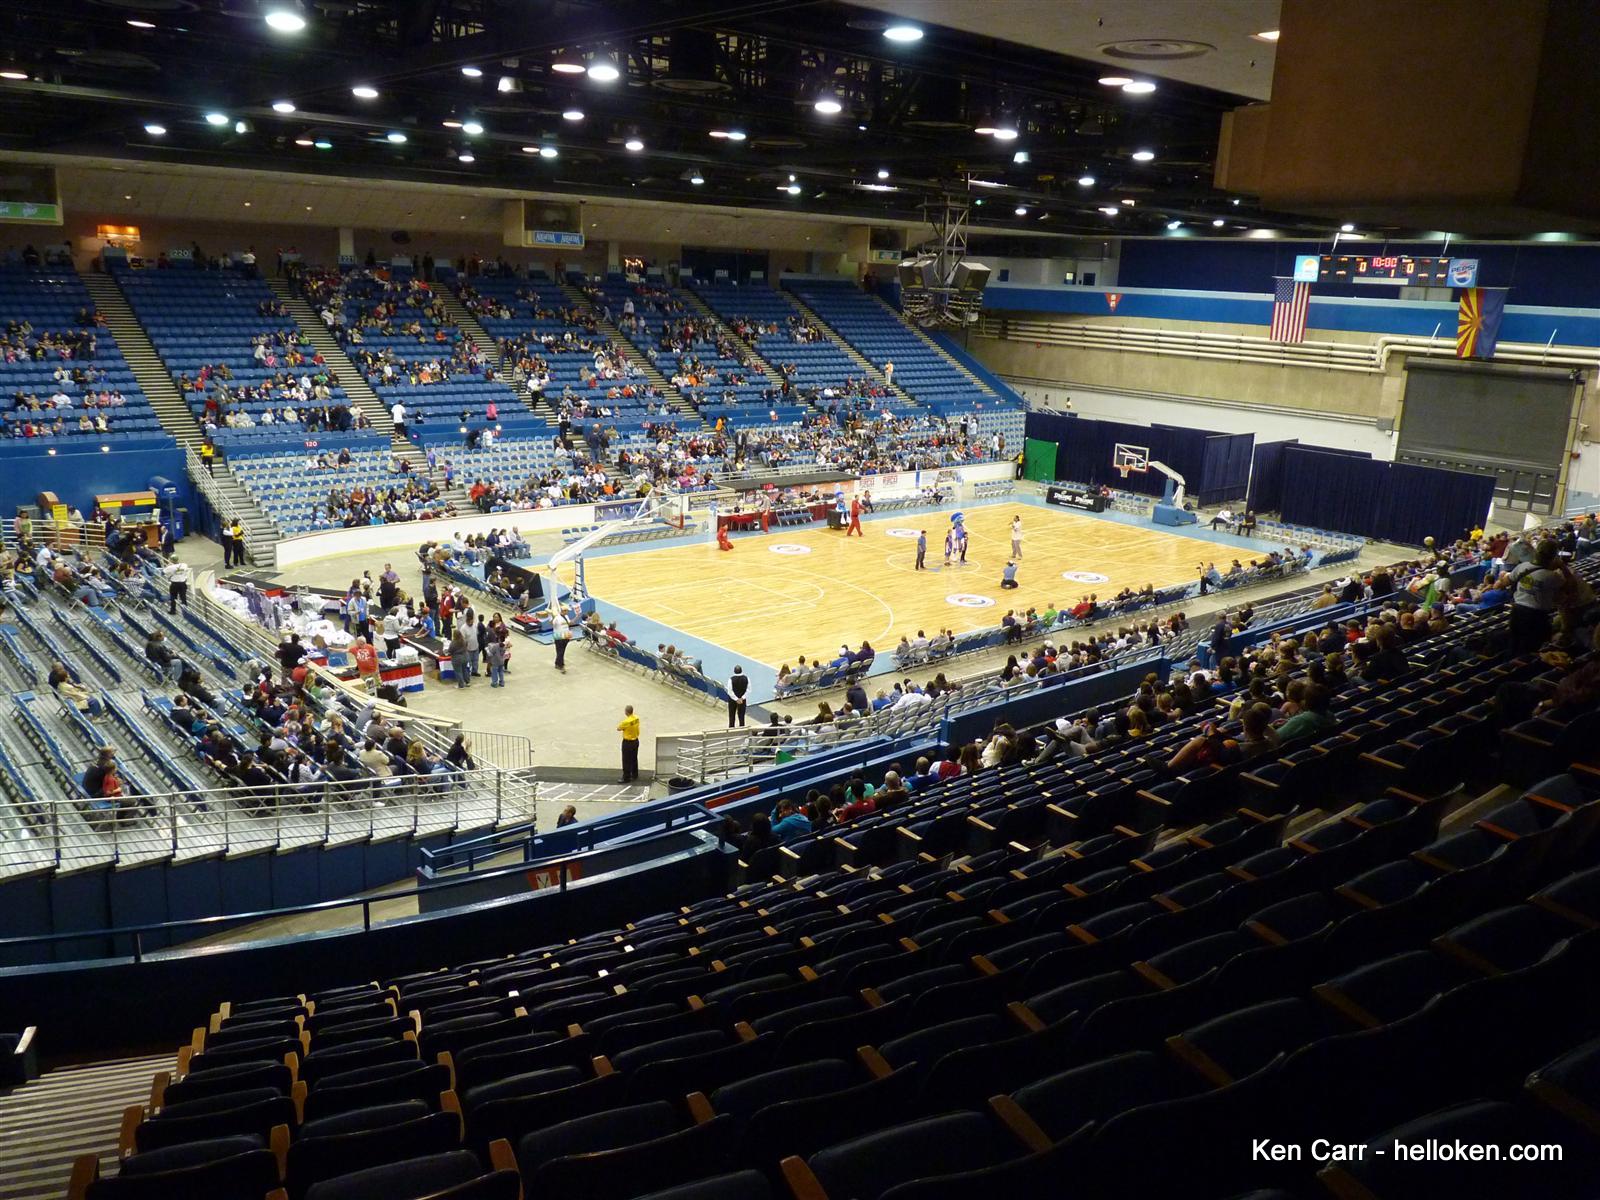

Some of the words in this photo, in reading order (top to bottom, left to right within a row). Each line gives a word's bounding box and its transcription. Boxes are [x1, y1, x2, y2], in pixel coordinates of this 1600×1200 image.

[173, 249, 189, 257] 220
[1359, 261, 1367, 272] 0
[1372, 257, 1398, 268] 10:00
[1390, 268, 1395, 278] 1
[1406, 262, 1415, 274] 0
[1451, 264, 1476, 272] PEPSI
